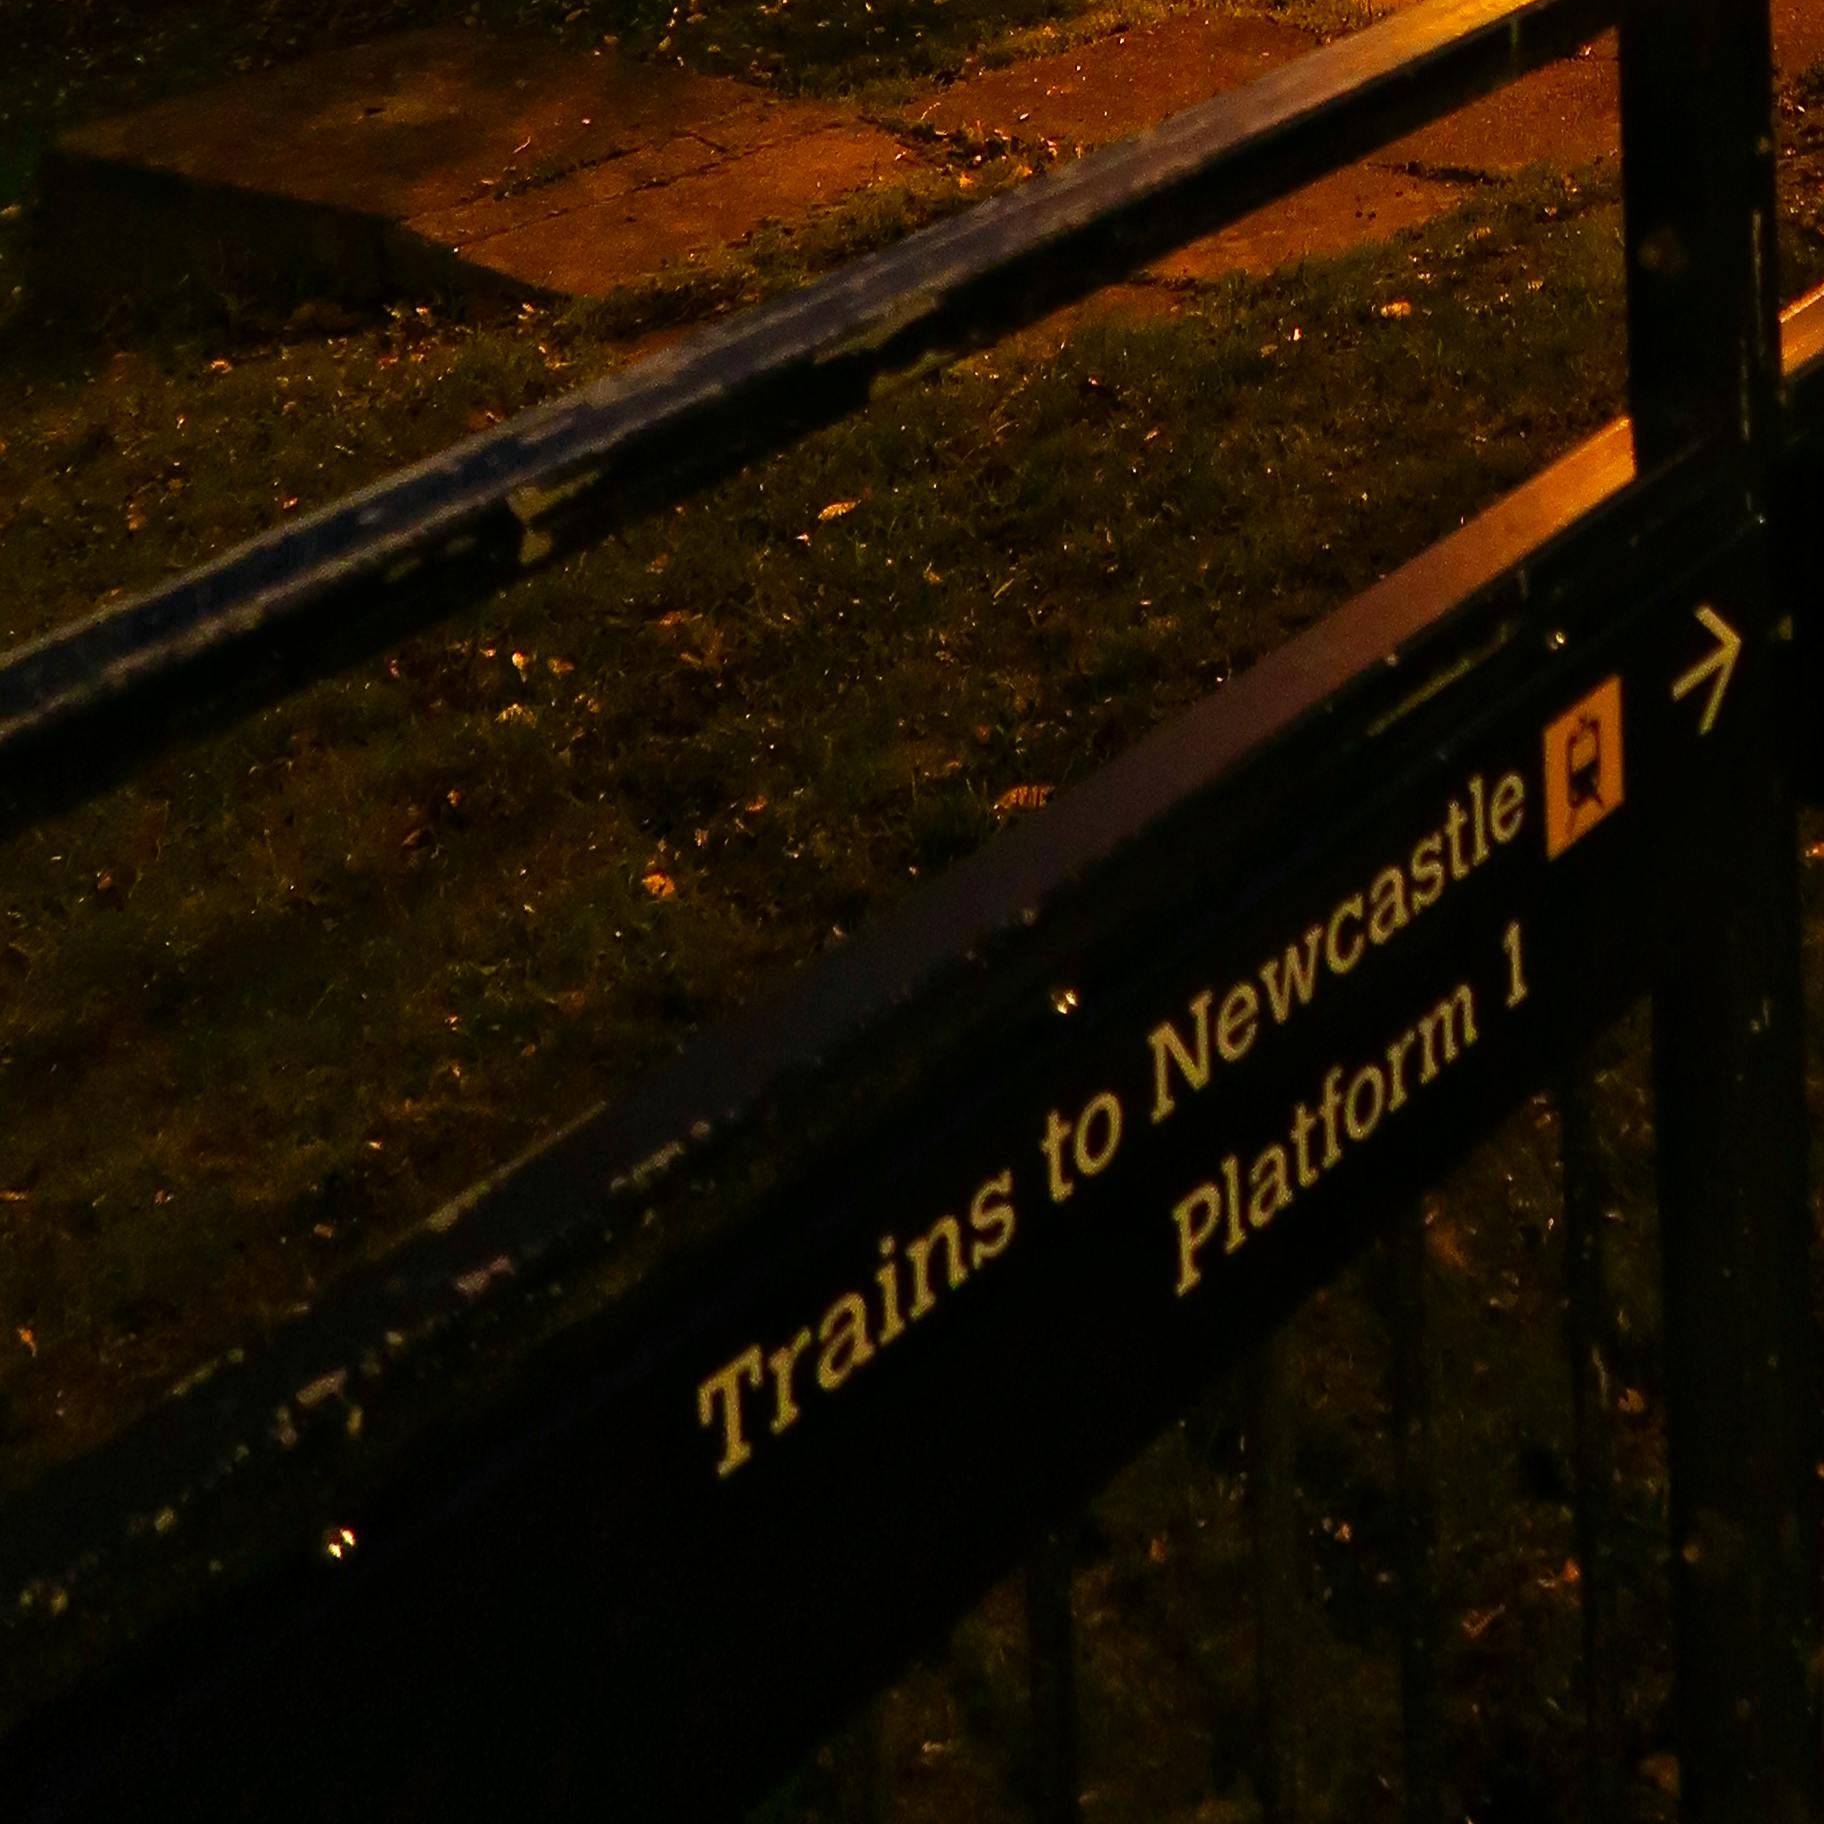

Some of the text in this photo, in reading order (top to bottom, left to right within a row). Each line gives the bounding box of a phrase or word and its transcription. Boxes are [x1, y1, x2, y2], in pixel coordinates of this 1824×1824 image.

[699, 773, 1524, 1475] Trains to Newcastle
[1173, 923, 1527, 1295] Platform 1
